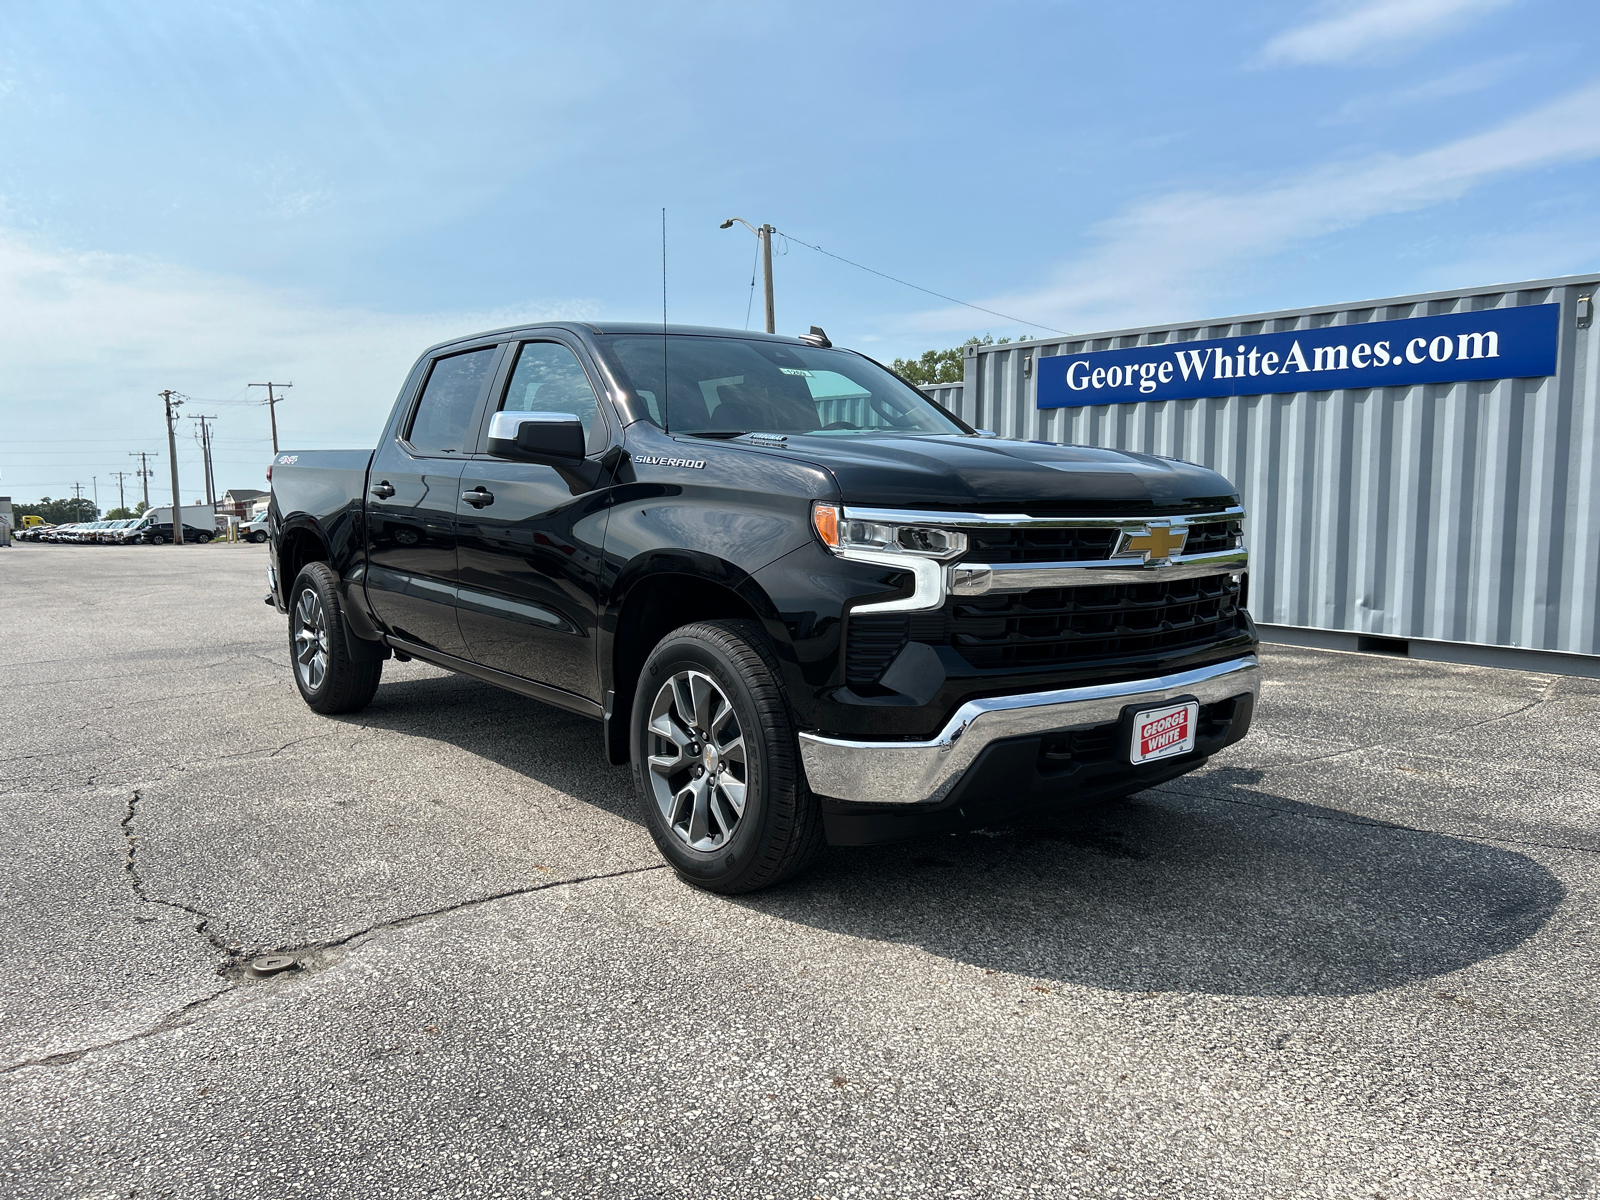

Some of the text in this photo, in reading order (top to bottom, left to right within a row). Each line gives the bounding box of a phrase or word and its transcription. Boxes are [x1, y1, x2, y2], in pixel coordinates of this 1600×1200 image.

[1066, 330, 1500, 394] GeorgeWhiteAmes.com
[634, 455, 706, 470] SILVERADO
[1143, 711, 1185, 738] GEORGE
[1148, 728, 1180, 751] WHITE
